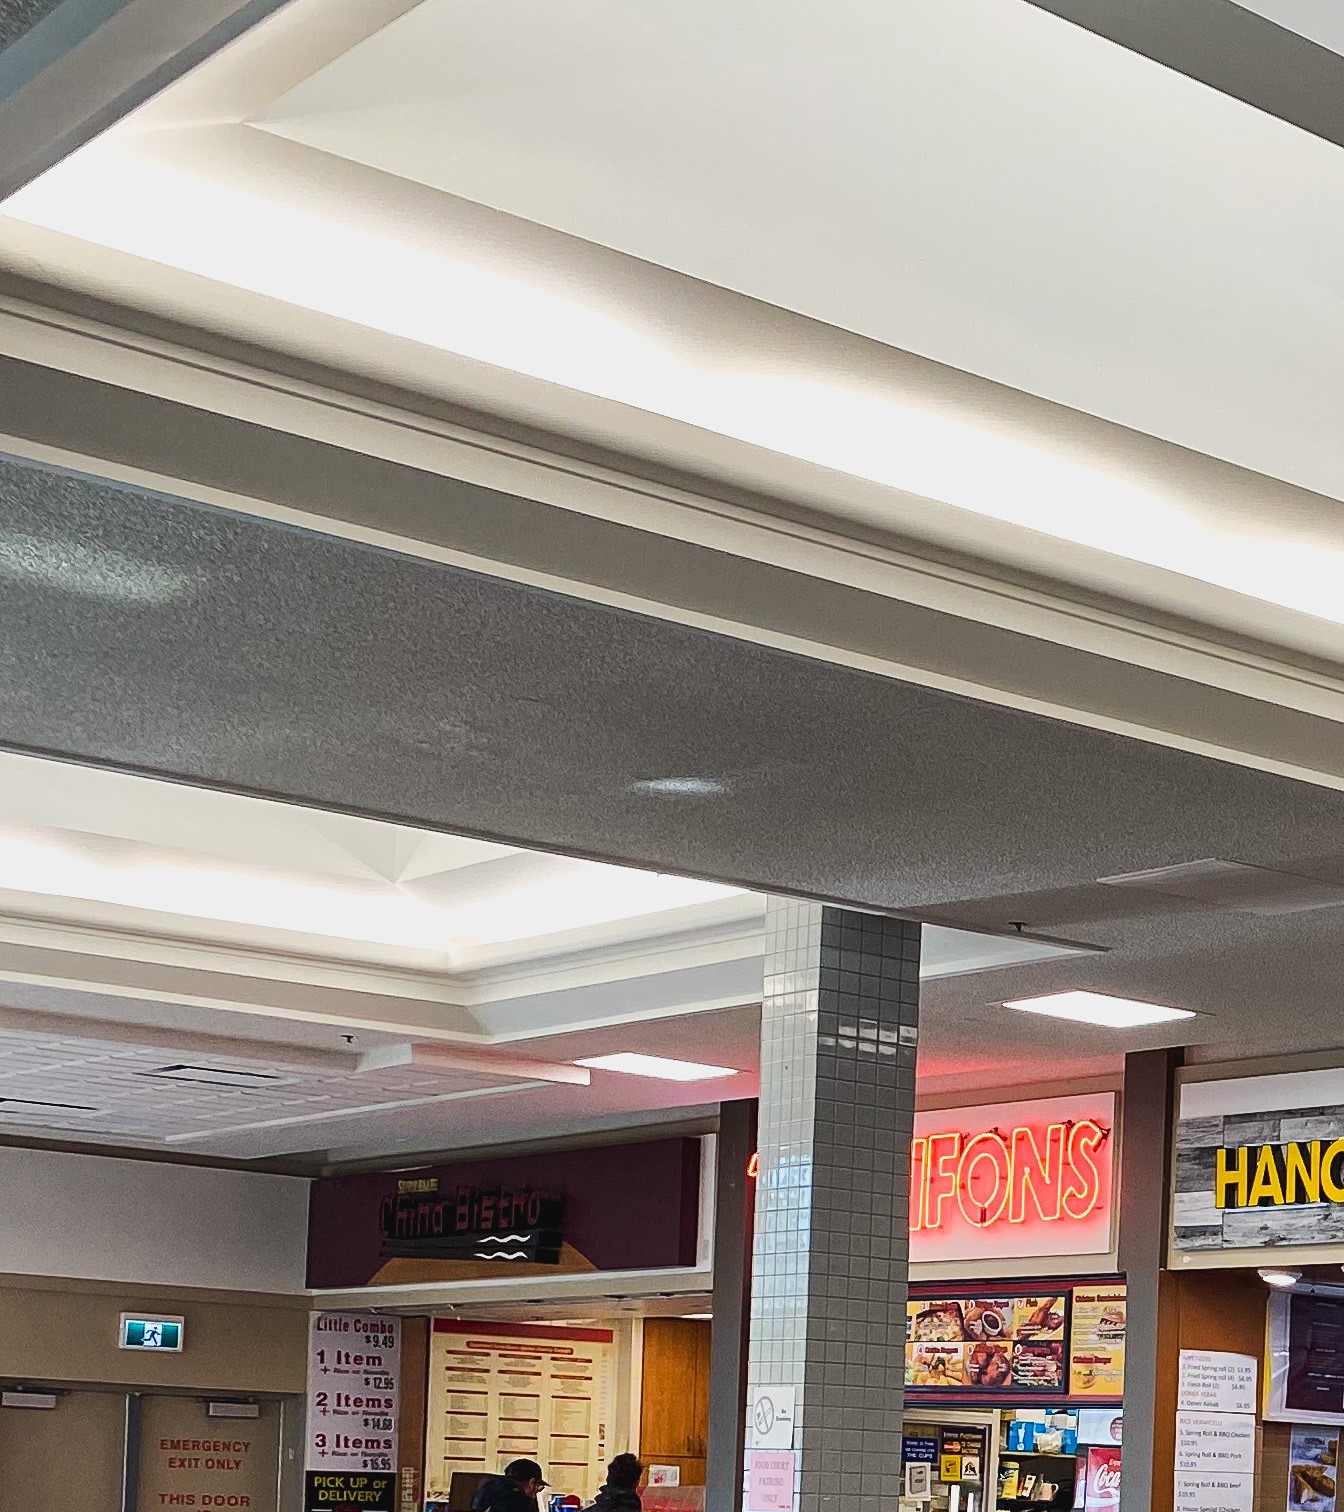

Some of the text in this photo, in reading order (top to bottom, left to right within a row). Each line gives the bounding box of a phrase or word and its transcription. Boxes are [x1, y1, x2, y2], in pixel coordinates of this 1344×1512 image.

[317, 1316, 394, 1334] Little Combo
[316, 1350, 382, 1366] 1 Item
[316, 1392, 393, 1408] 2 Items
[160, 1439, 251, 1452] EMERGENCY
[315, 1434, 392, 1449] 3 Items
[168, 1458, 242, 1470] EXIT ONLY
[755, 1461, 789, 1469] FOOD COURT
[315, 1477, 387, 1488] PICK UP or
[759, 1477, 784, 1486] PATRONS
[159, 1494, 251, 1507] THIS DOOR
[319, 1490, 382, 1501] DELIVERY
[763, 1494, 778, 1502] ONLY
